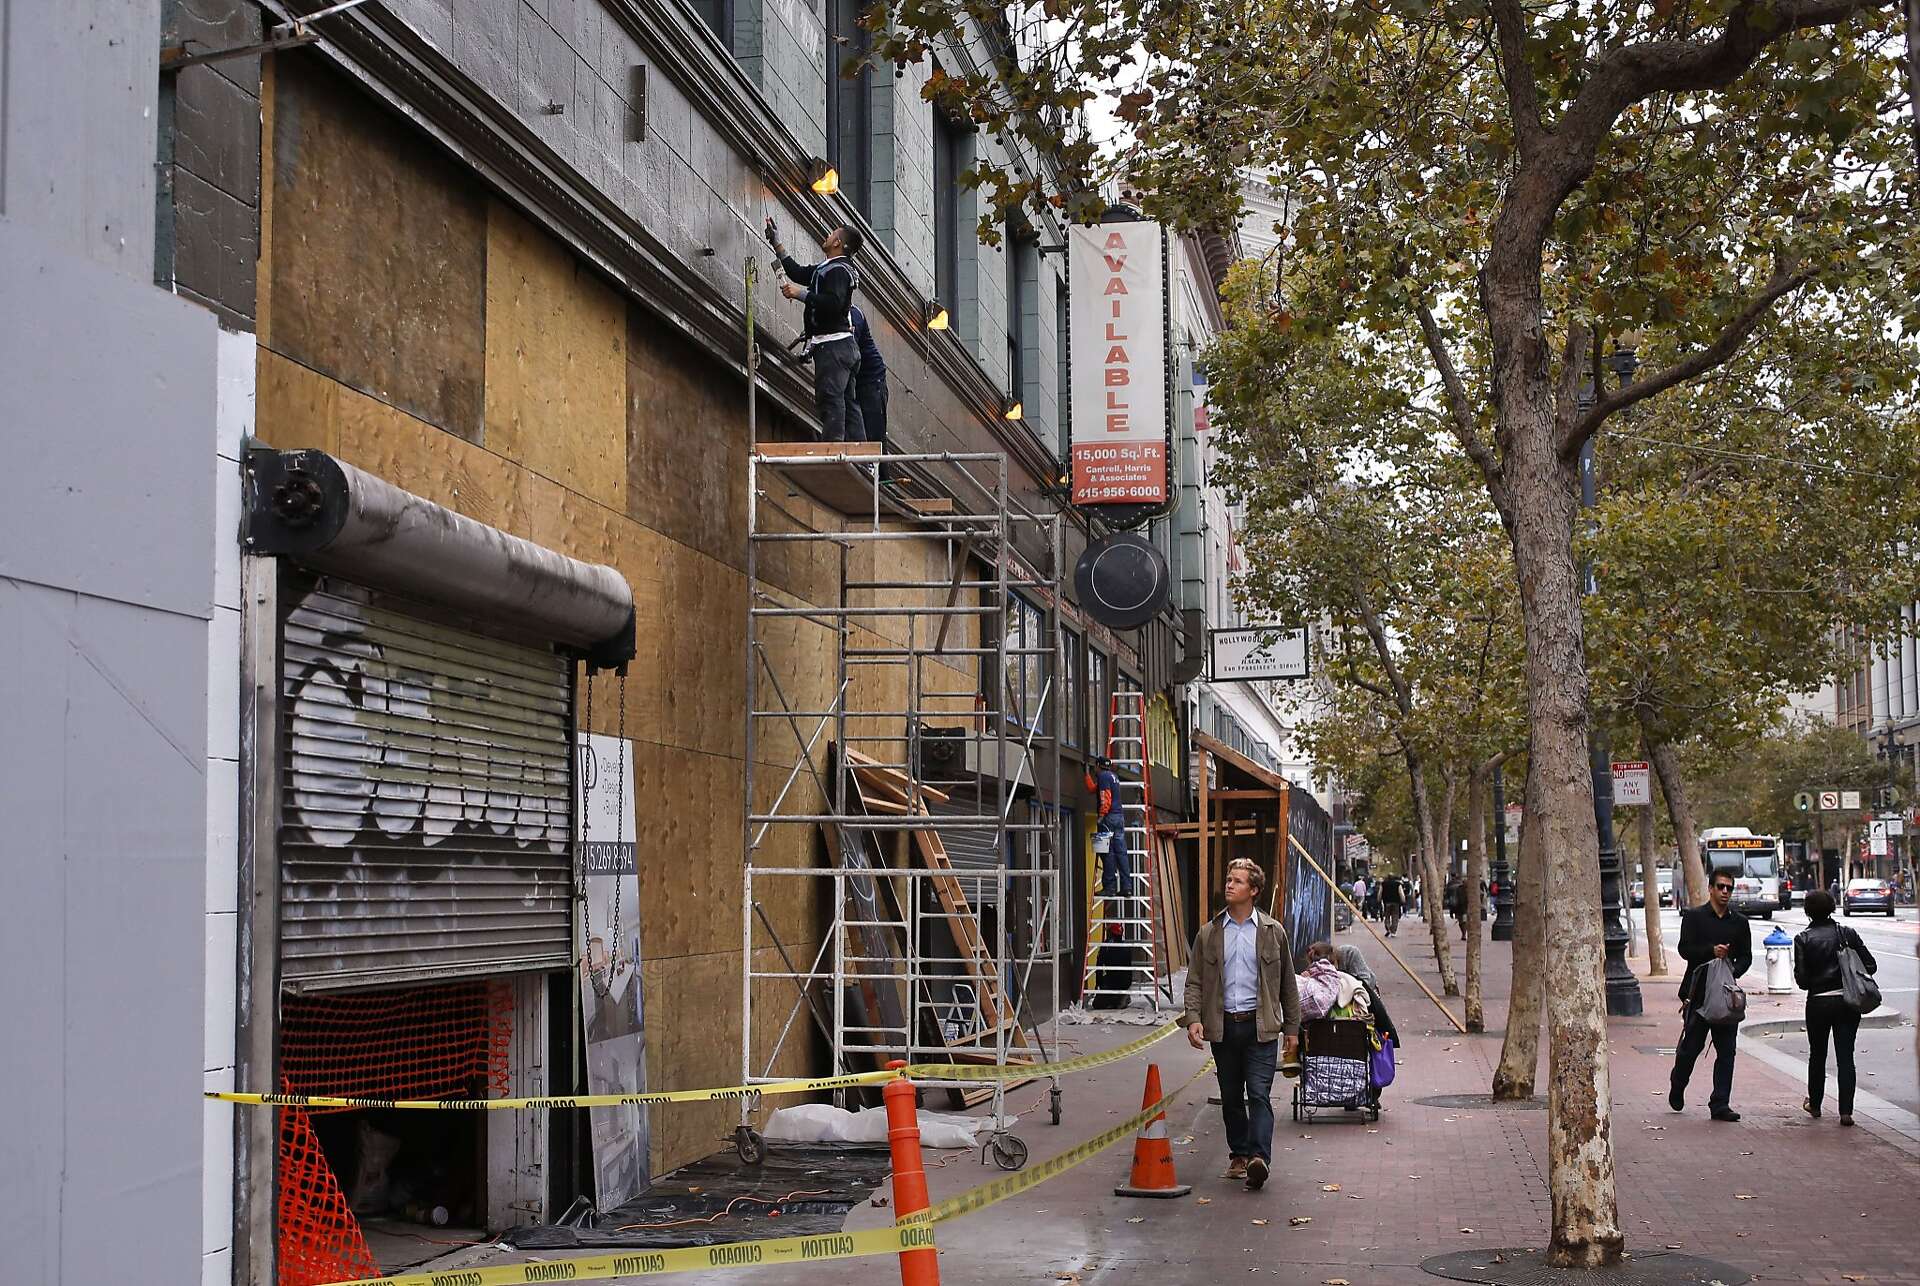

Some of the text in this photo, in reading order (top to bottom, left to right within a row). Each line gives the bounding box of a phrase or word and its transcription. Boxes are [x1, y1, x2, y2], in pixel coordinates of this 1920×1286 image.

[1103, 232, 1130, 433] AVAILABLE
[1076, 447, 1161, 461] 15,000 Sq. Ft.
[1085, 463, 1152, 474] Cantrell, Harris
[1099, 473, 1147, 482] Associates
[1613, 769, 1624, 778] NO
[1623, 788, 1641, 796] TIME
